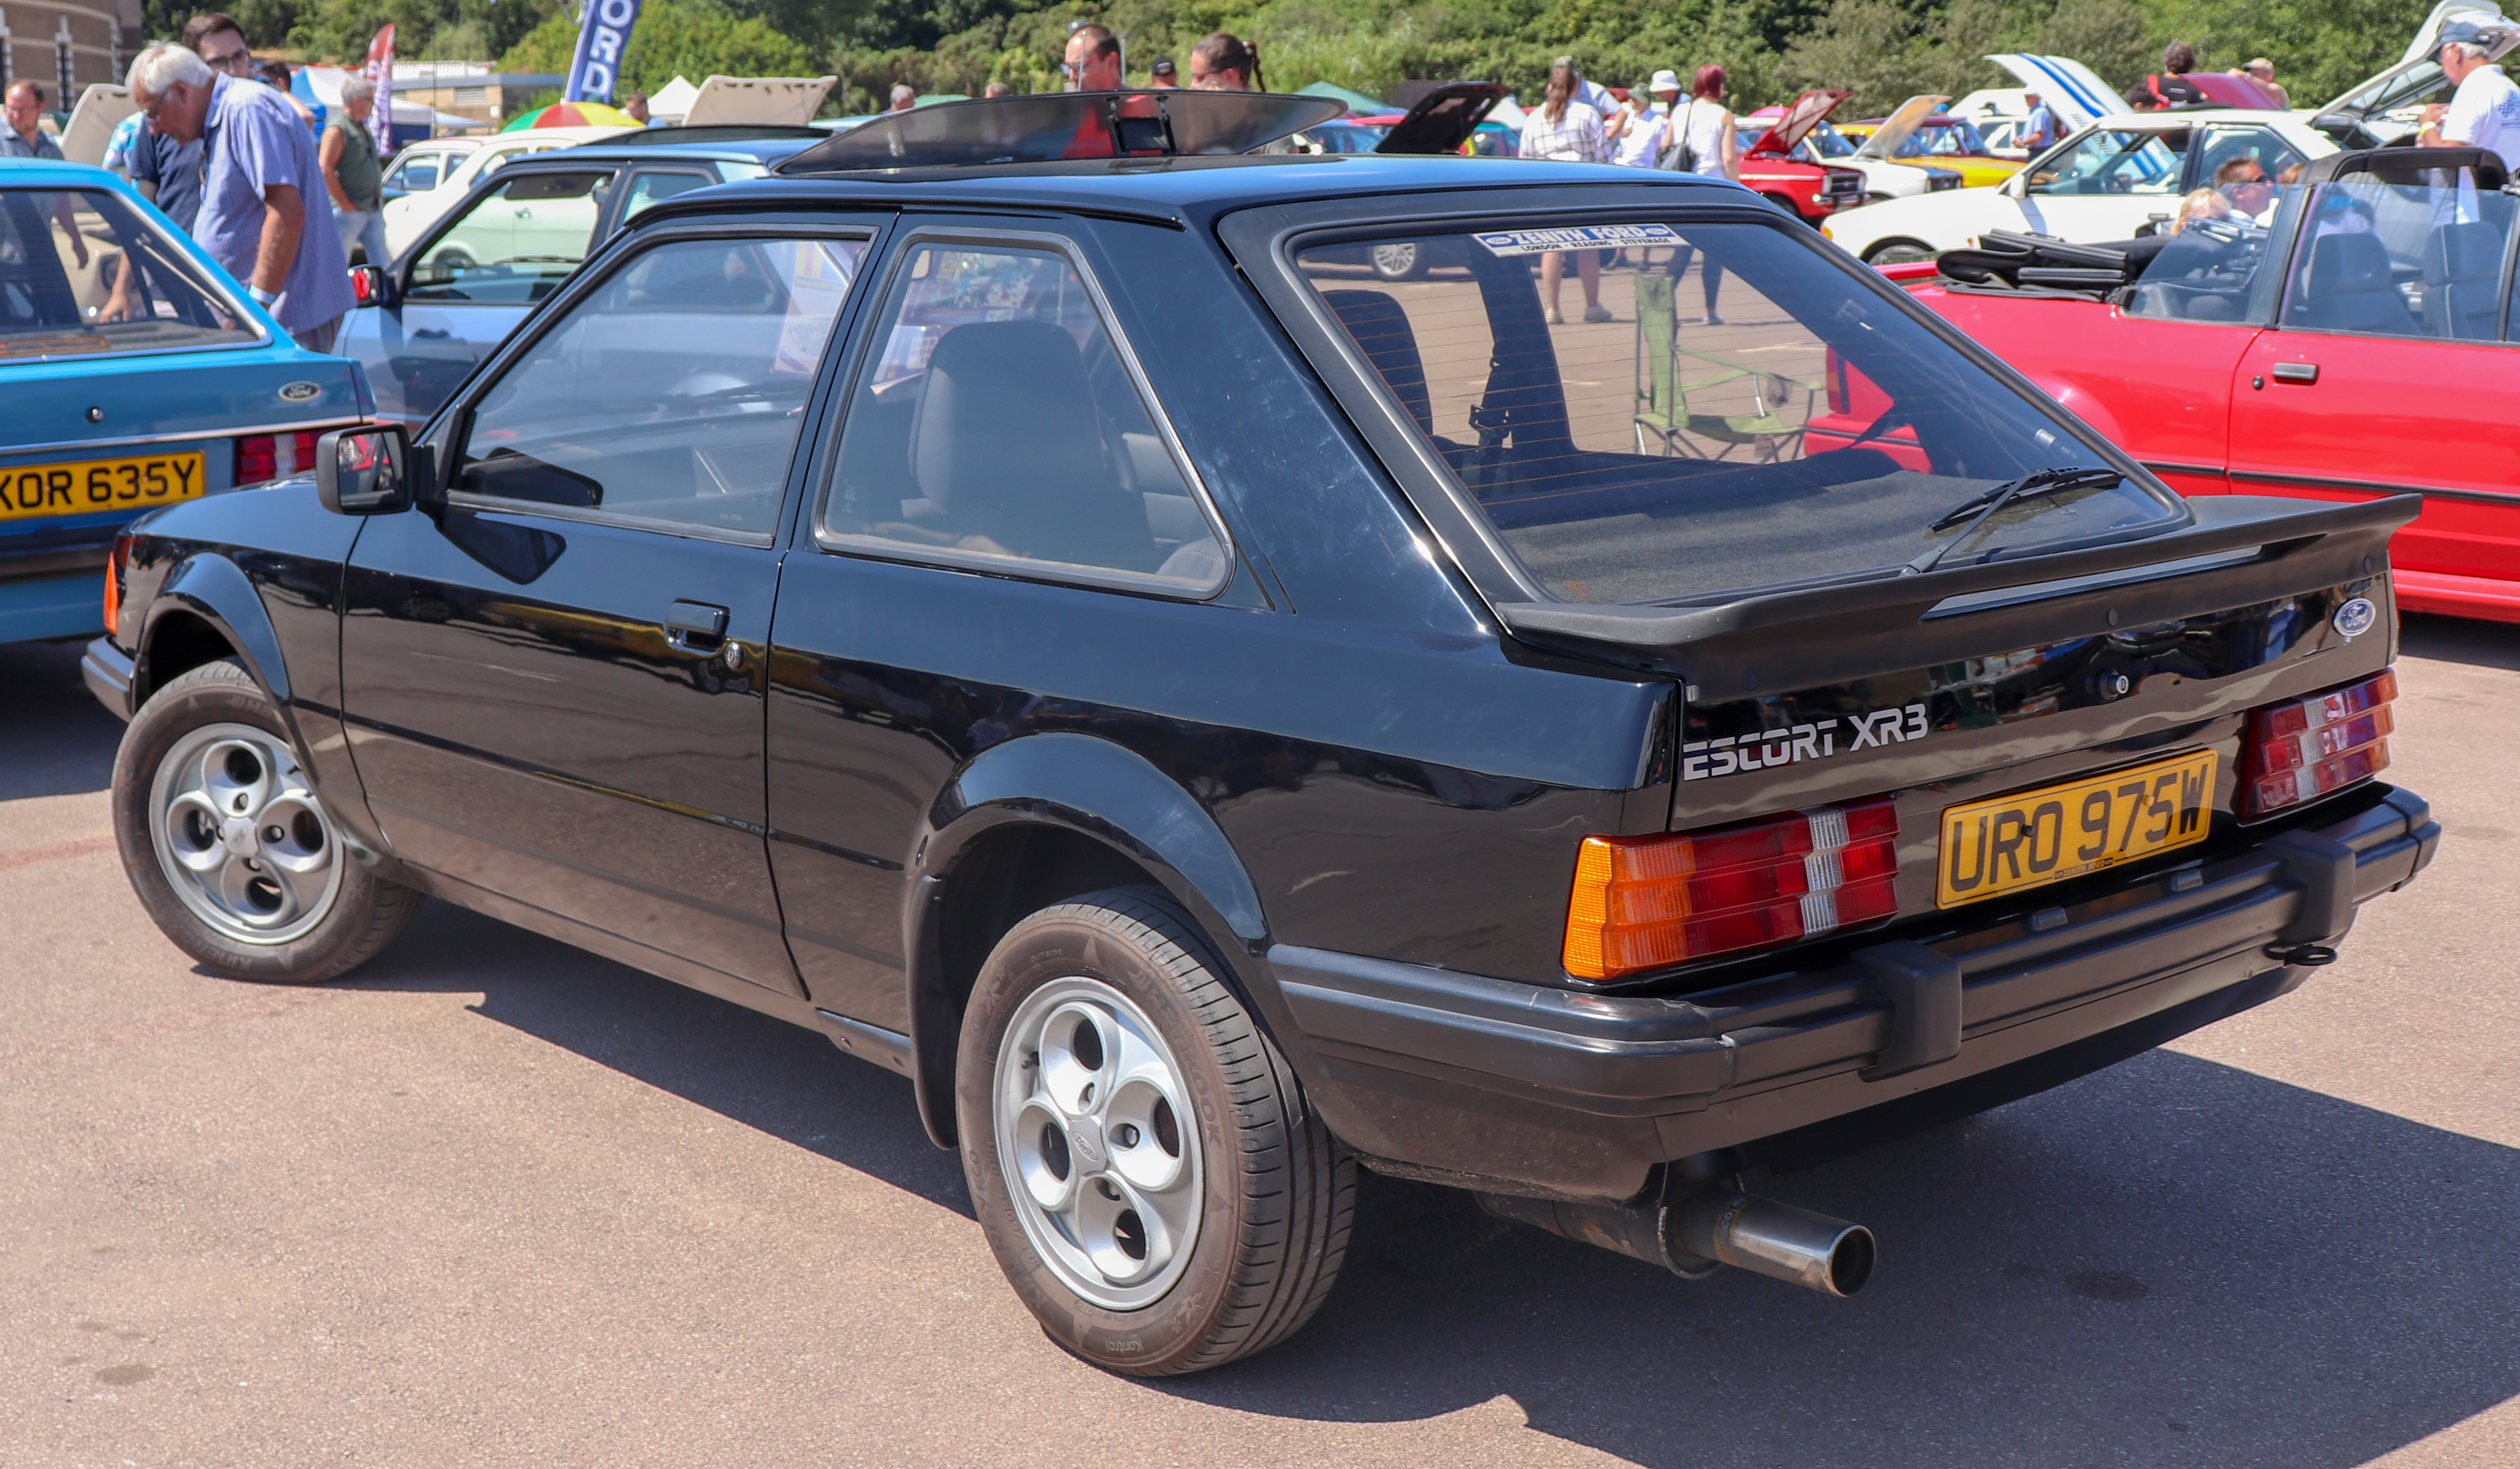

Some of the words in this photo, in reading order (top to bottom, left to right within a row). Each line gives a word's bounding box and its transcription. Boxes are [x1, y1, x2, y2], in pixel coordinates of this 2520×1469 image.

[1507, 228, 1590, 244] ZENITH
[1589, 226, 1648, 239] FORD
[87, 458, 195, 502] 635Y
[1683, 719, 1837, 781] ESCORT
[1848, 703, 1928, 752] XR3
[1950, 801, 2063, 892] URO
[2078, 764, 2208, 861] 975W
[2063, 864, 2087, 876] ZENITH
[2088, 859, 2105, 871] FORD
[1030, 949, 1062, 963] OUTSIDE
